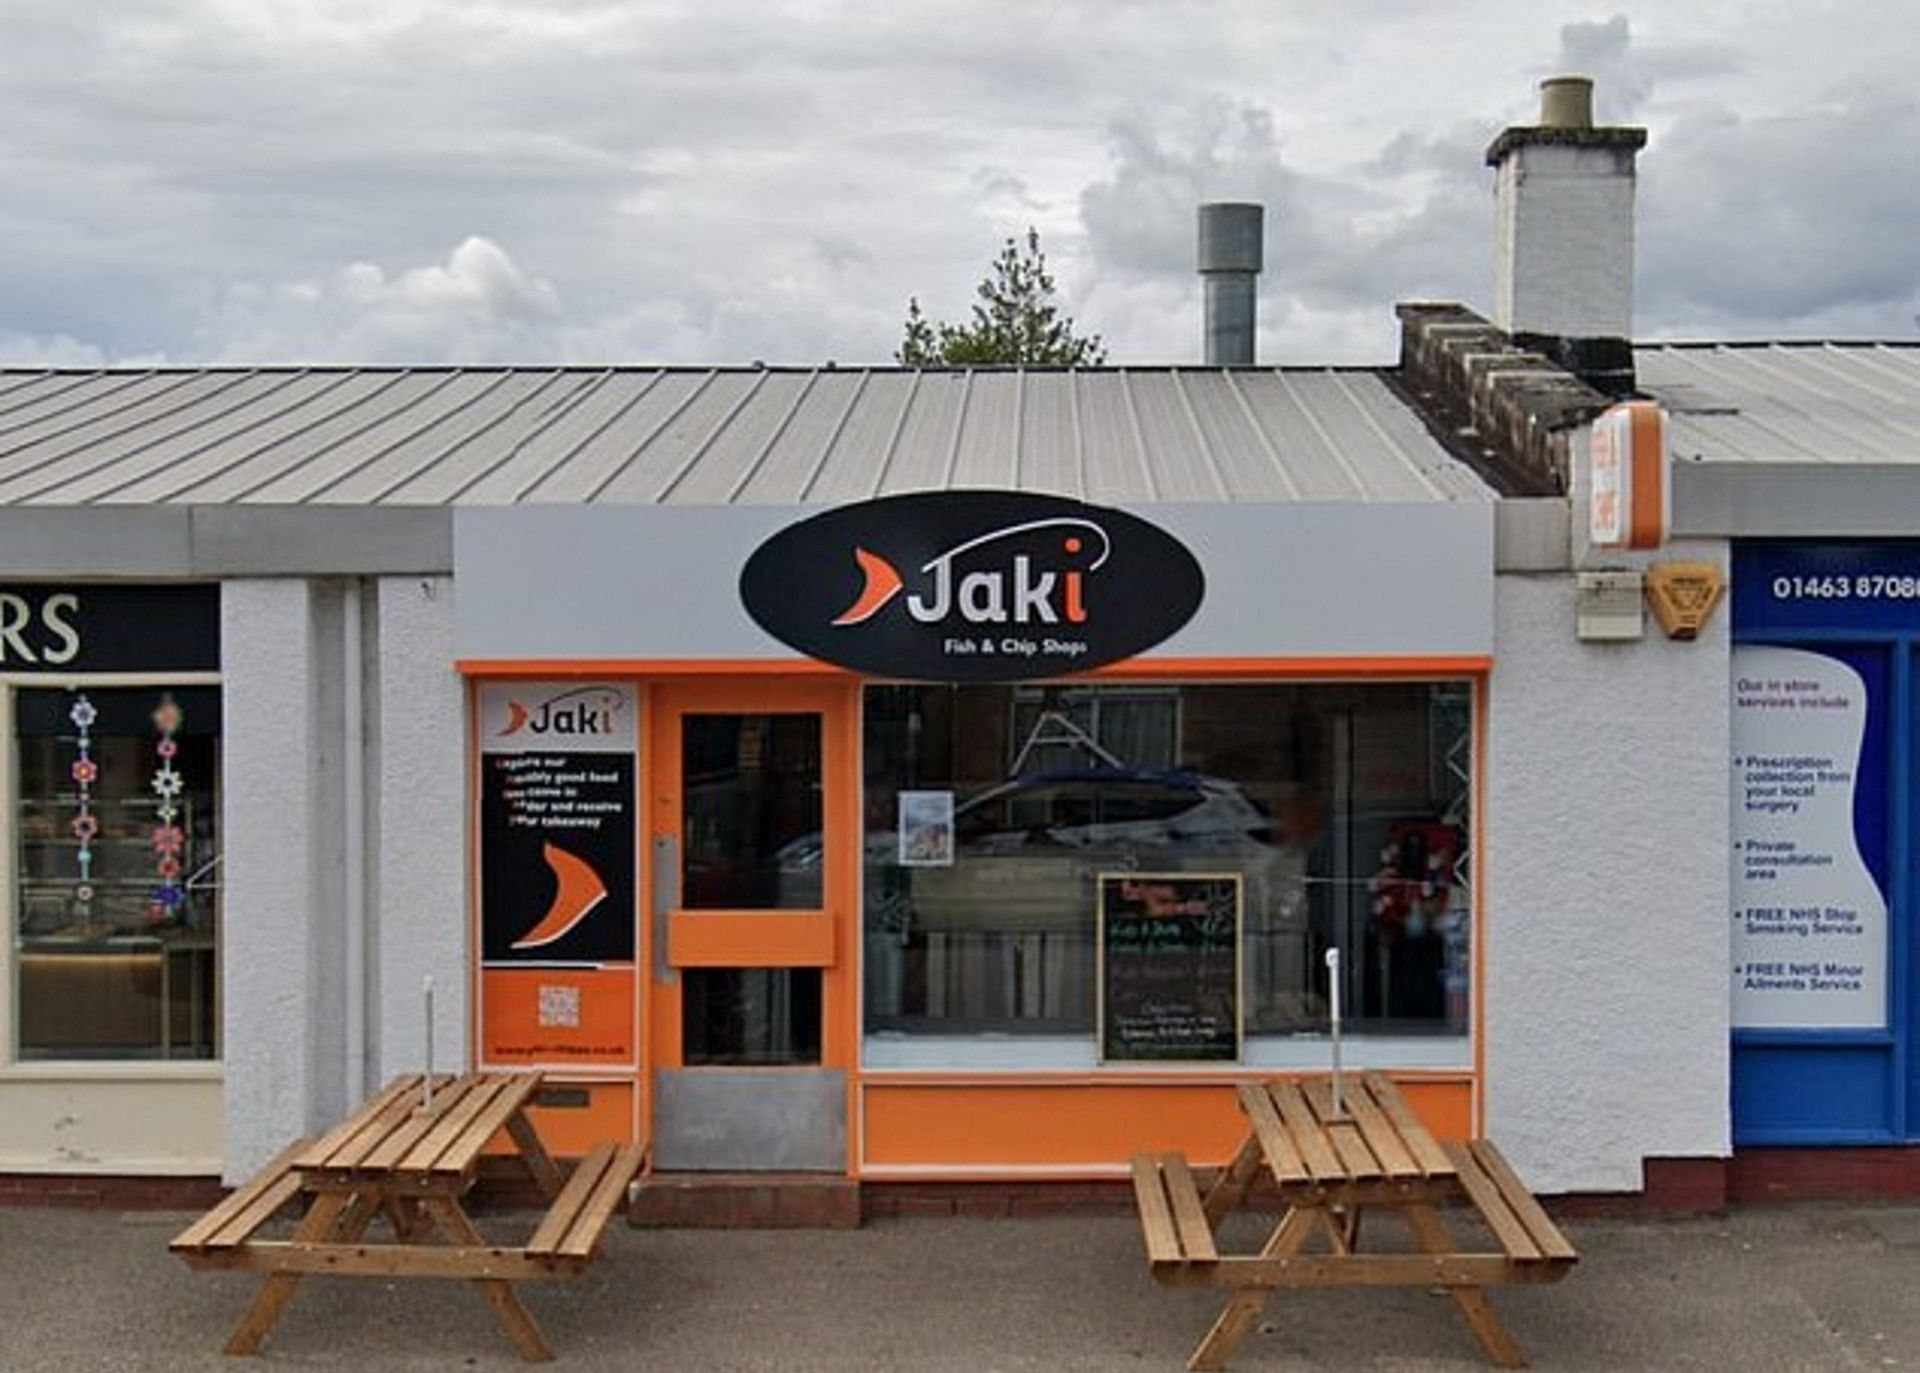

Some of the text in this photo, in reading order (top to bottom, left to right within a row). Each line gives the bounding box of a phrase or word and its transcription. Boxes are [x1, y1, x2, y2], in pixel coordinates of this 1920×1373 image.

[907, 537, 1087, 624] Jaki
[1773, 576, 1850, 599] 01463
[944, 638, 1088, 657] Fish & Chip Shops
[1738, 678, 1820, 692] Our in store
[1737, 696, 1849, 709] services include
[530, 697, 613, 734] Jaki
[1746, 756, 1833, 769] Prescription
[1746, 771, 1851, 784] collection from
[1745, 785, 1815, 799] your local
[1745, 801, 1798, 814] surgery
[1746, 838, 1796, 851] Private
[1745, 854, 1833, 866] consultation
[1745, 869, 1777, 880] area
[1746, 908, 1784, 920] FREE
[1789, 908, 1821, 920] NHS
[1746, 922, 1863, 937] Smoking Service
[1746, 962, 1864, 976] FREE NHS Minor
[1745, 977, 1862, 990] Ailments Service
